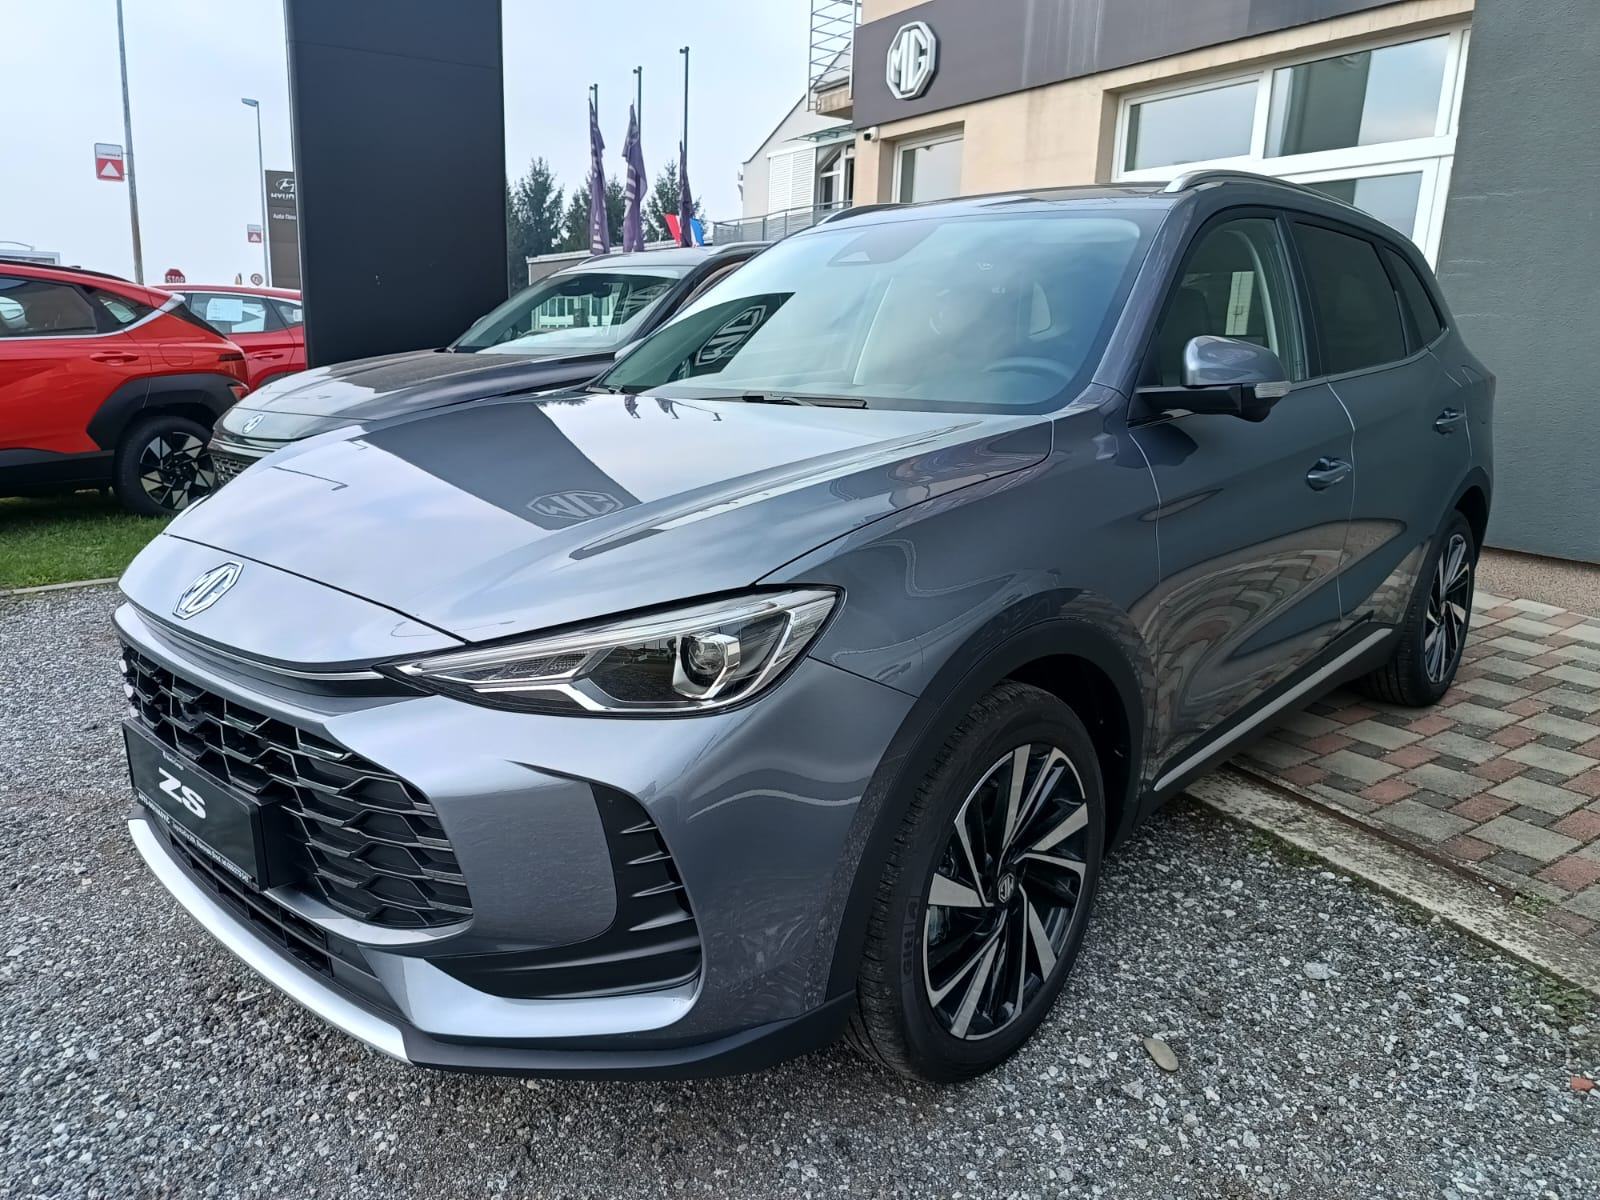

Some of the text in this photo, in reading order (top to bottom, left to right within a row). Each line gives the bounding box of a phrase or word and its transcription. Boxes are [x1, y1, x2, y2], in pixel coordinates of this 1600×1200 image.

[888, 25, 931, 94] MG
[167, 275, 185, 284] STOP
[177, 564, 240, 615] MG
[158, 766, 207, 820] ZS
